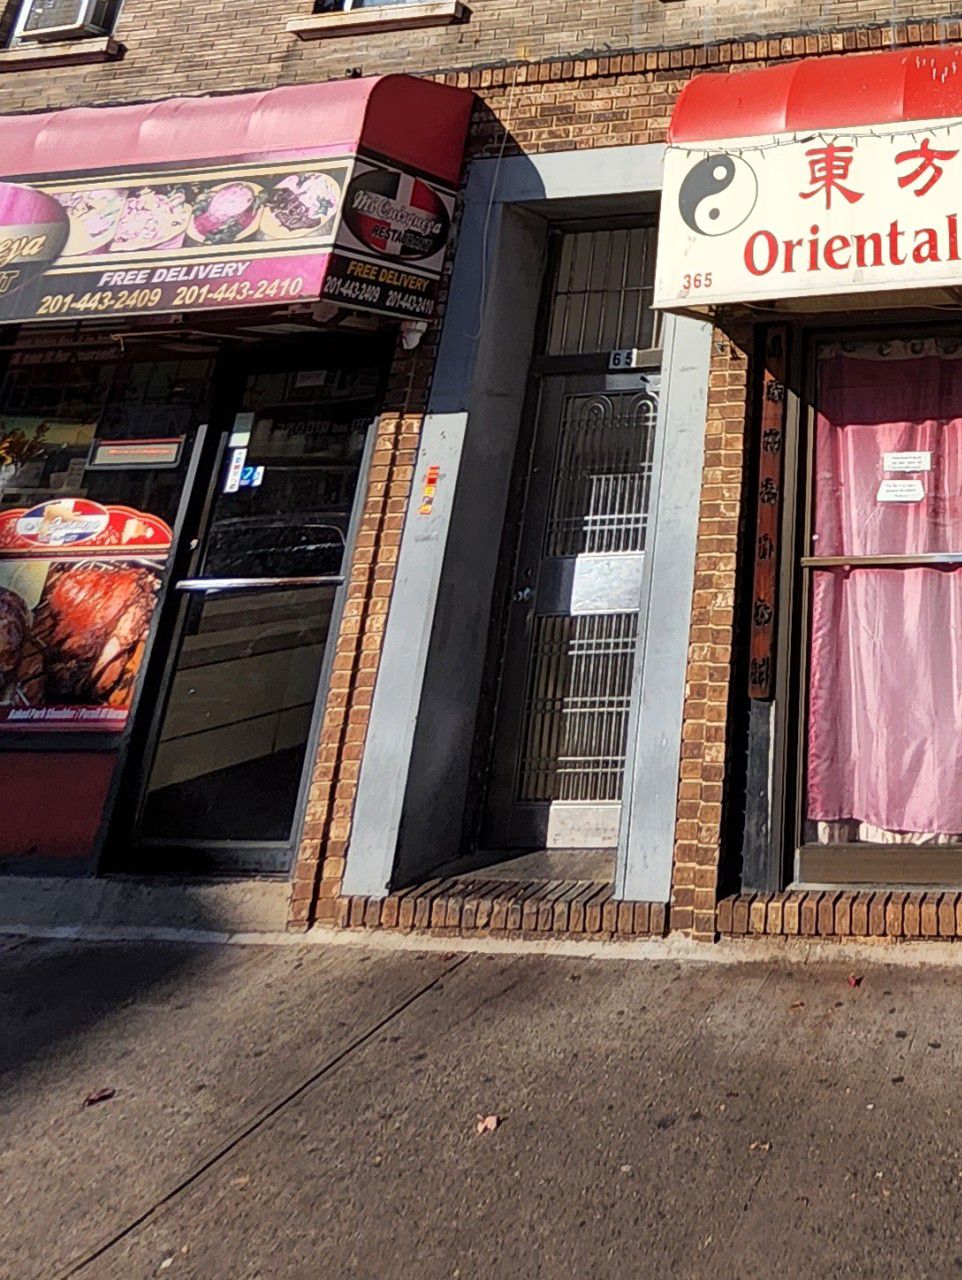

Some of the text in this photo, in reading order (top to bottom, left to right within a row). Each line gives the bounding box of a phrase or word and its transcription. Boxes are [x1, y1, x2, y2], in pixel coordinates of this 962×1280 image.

[743, 212, 961, 277] Oriental
[97, 261, 251, 288] FREE DELIVERY
[324, 275, 381, 303] 201-443-2409
[347, 261, 430, 293] FREE DELIVERY
[682, 272, 713, 291] 365
[35, 277, 304, 315] 201-443-2409 201-443-2410
